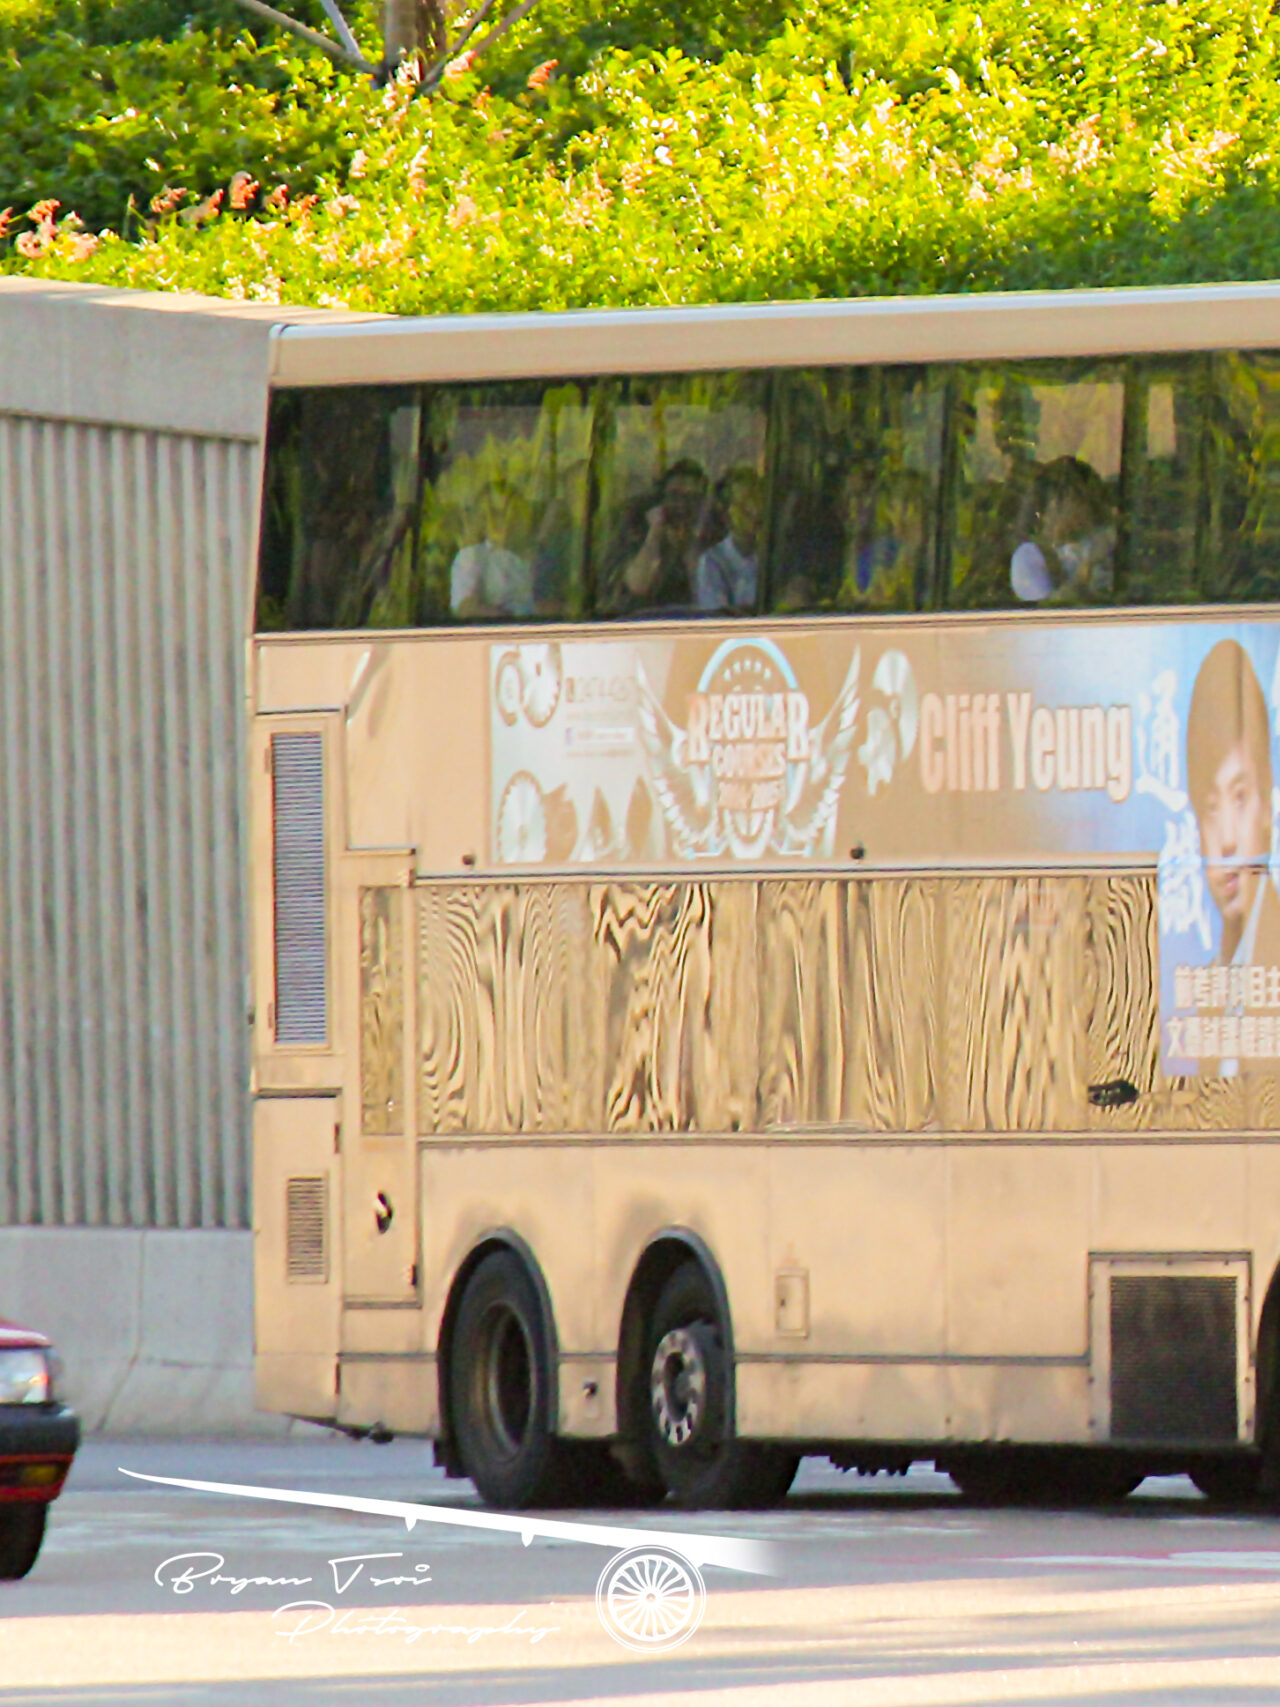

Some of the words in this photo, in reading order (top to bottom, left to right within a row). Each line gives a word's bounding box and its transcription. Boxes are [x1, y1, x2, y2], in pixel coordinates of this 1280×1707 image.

[683, 693, 810, 763] REGULAR
[920, 692, 1000, 793] Cliff
[1006, 692, 1132, 803] Yeung
